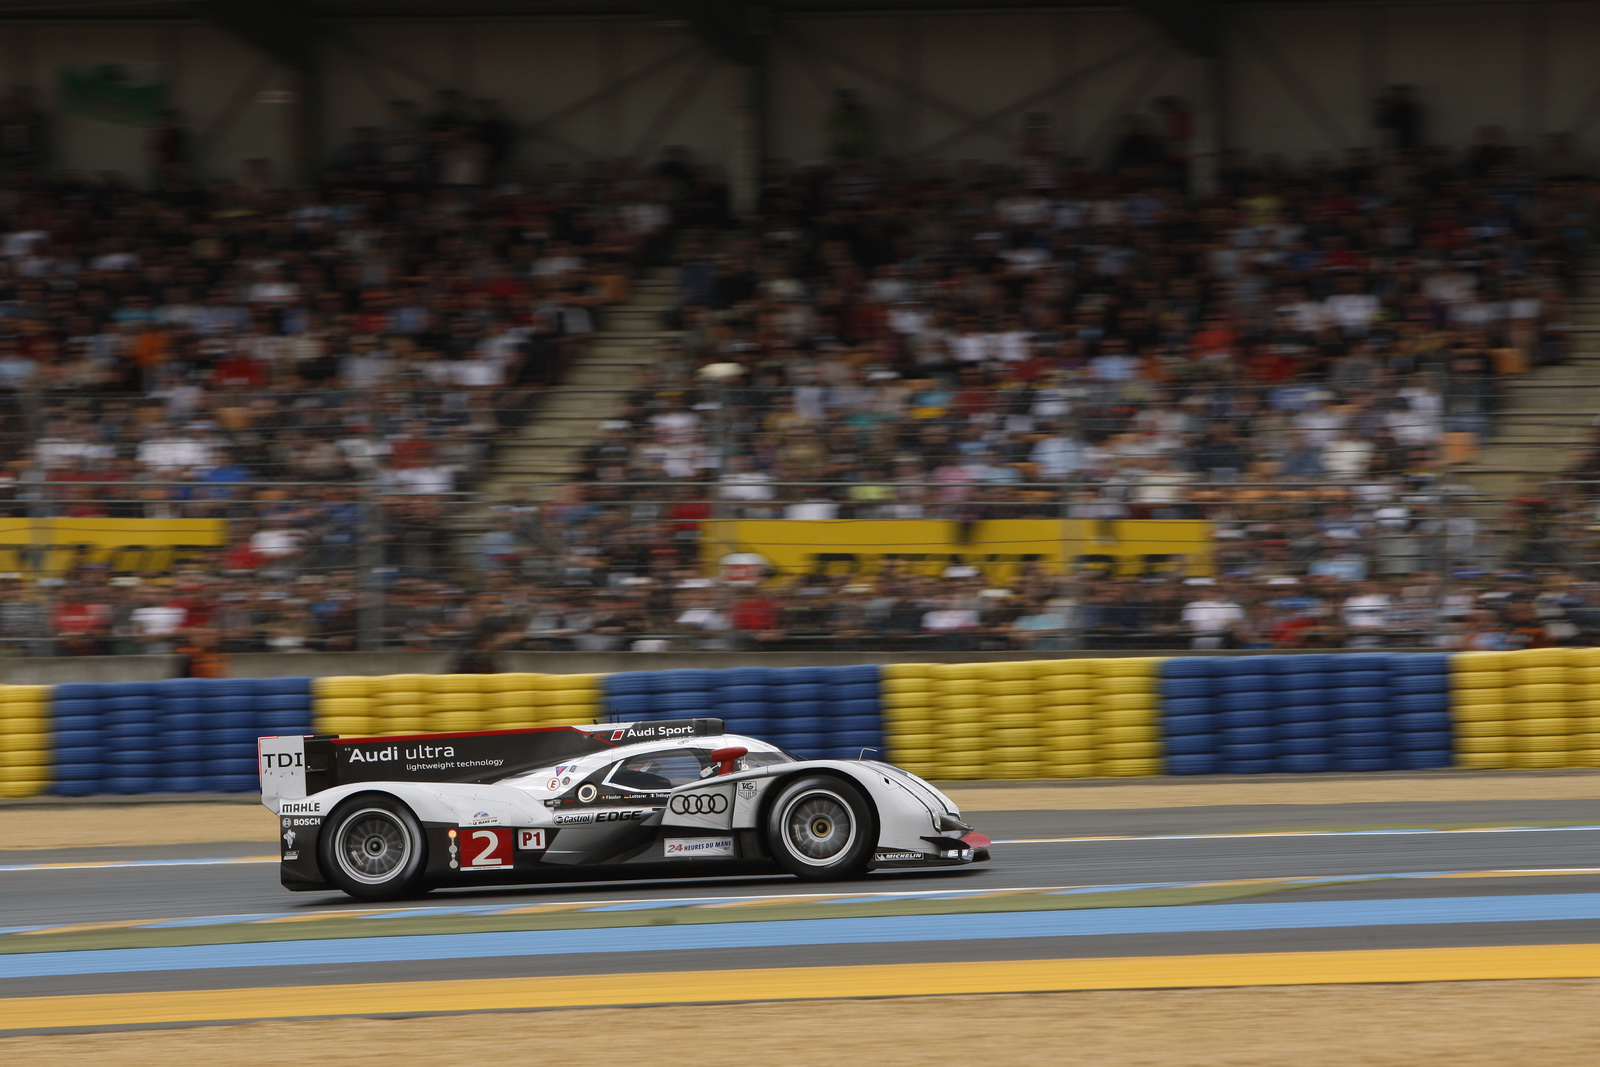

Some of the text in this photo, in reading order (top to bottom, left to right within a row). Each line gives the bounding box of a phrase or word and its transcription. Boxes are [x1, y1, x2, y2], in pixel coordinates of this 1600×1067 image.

[627, 725, 694, 738] Audi Sport
[262, 752, 303, 768] TDI
[349, 745, 455, 763] Audi ultra
[406, 758, 504, 771] lightweight technology
[282, 803, 320, 813] MAHLE
[293, 818, 321, 826] BOSCH
[563, 810, 643, 824] Castrol EDGE
[522, 832, 541, 847] P1
[472, 830, 502, 866] 2
[667, 843, 683, 854] 24
[683, 843, 705, 851] HEURES
[714, 840, 732, 848] MANS
